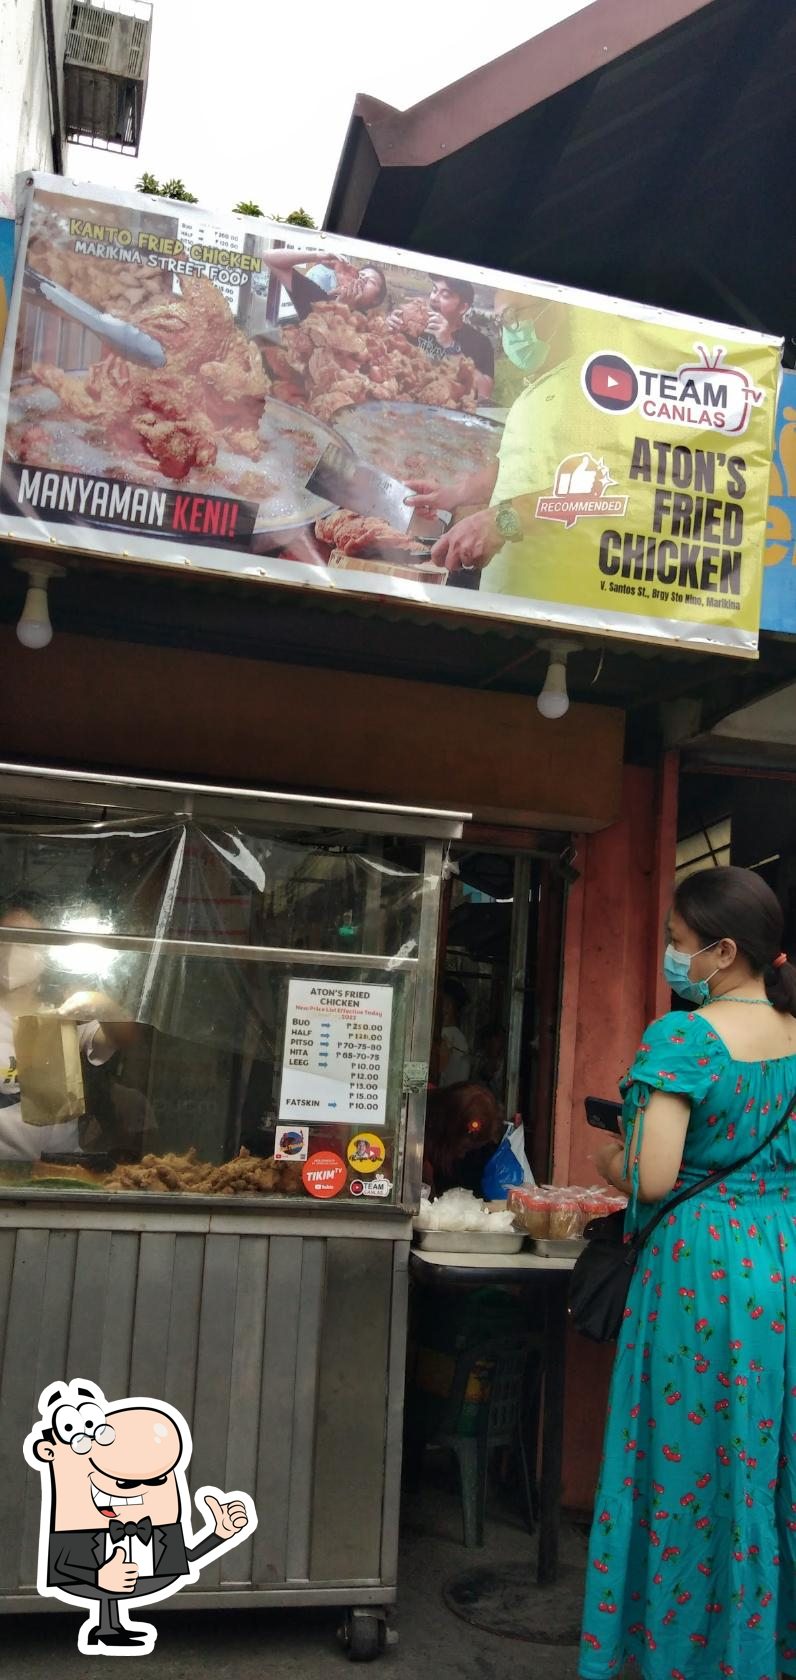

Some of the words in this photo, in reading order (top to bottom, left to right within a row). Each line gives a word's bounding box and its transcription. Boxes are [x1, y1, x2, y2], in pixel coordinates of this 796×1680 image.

[70, 218, 132, 247] KANTO
[139, 232, 184, 256] FRIED
[190, 243, 262, 273] CHICKEN
[75, 240, 142, 264] MARIKINA
[148, 255, 206, 278] STREET
[208, 265, 249, 286] FOOD
[639, 370, 728, 409] TEAM
[741, 388, 762, 403] TV
[643, 400, 726, 428] CANLAS
[629, 436, 747, 500] ATON'S
[17, 469, 167, 527] MANYAMAN
[172, 495, 239, 537] KENI!
[540, 501, 623, 513] RECOMMENDED
[652, 488, 744, 548] FRIED
[598, 529, 742, 595] CHICKEN
[600, 580, 607, 591] V.
[609, 582, 635, 596] Santos
[652, 588, 669, 602] Brgy
[670, 591, 683, 603] Sto
[706, 596, 741, 611] Marikina
[310, 987, 343, 997] ATON'S
[344, 990, 370, 999] FRIED
[320, 998, 360, 1007] CHICKEN
[292, 1018, 310, 1026] BUO
[289, 1058, 309, 1066] LEEG
[286, 1098, 320, 1107] FATSKIN
[306, 1170, 335, 1182] TIKIM
[363, 1182, 384, 1190] TEAM
